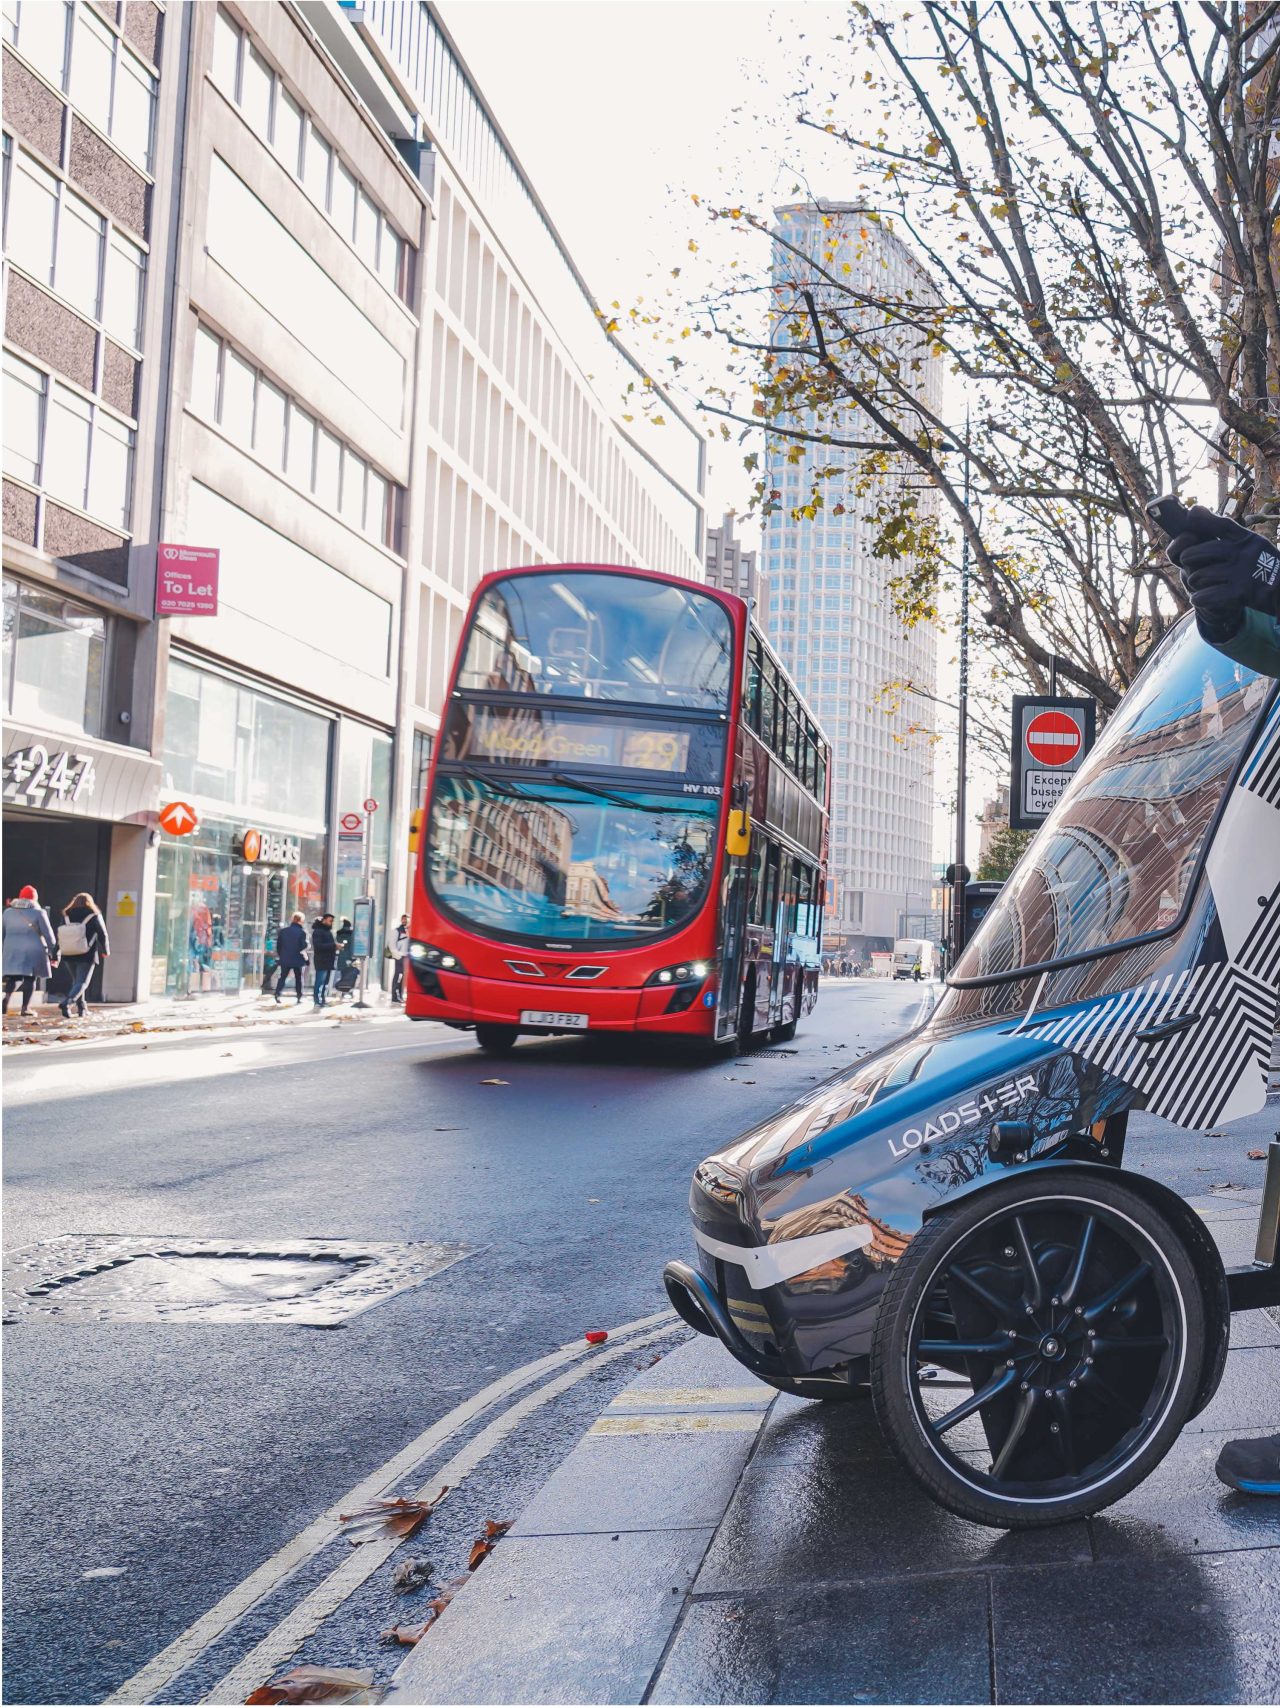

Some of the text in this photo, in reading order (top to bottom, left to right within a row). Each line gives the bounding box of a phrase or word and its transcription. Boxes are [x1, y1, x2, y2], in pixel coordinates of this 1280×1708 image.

[164, 570, 192, 580] Offices
[163, 580, 214, 597] To Let
[480, 729, 544, 755] Wood
[550, 735, 610, 759] Green
[1034, 775, 1072, 787] Except
[683, 783, 721, 795] HV 103
[1031, 786, 1063, 797] buses
[1035, 798, 1058, 810] cycl
[260, 832, 300, 866] Blacks
[528, 1012, 581, 1026] LJ13 FBZ
